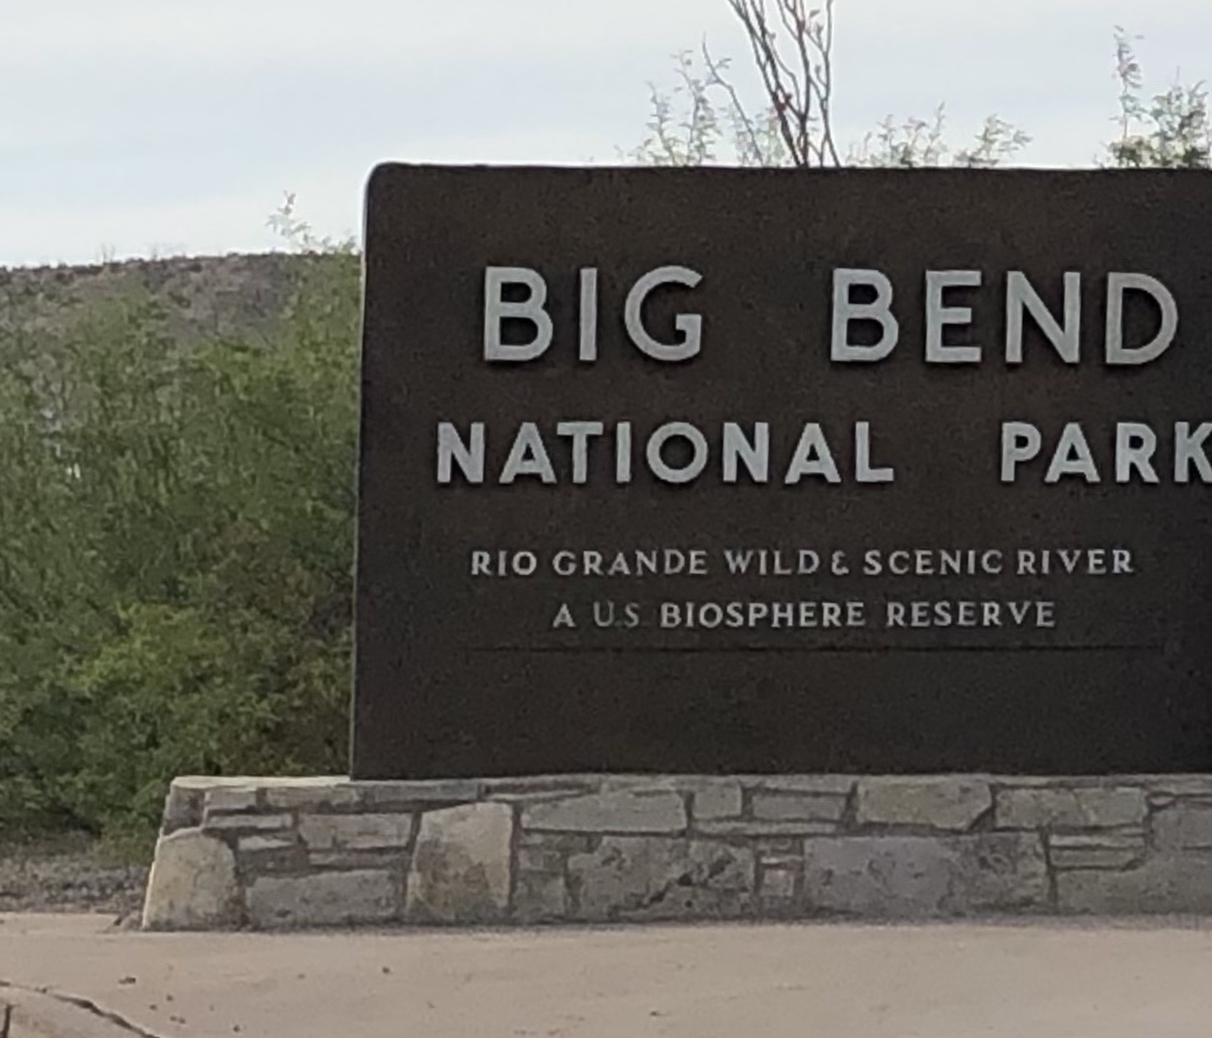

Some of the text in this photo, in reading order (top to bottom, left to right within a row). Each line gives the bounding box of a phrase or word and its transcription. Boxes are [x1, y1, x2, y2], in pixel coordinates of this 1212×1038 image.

[482, 265, 1179, 365] BIG BEND
[437, 421, 895, 484] NATIONAL
[471, 549, 1134, 576] RIO GRANDE WILD & SCENIC RIVER
[553, 603, 576, 628] A
[660, 602, 866, 628] BIOSPHERE
[886, 601, 1055, 627] RESERVE
